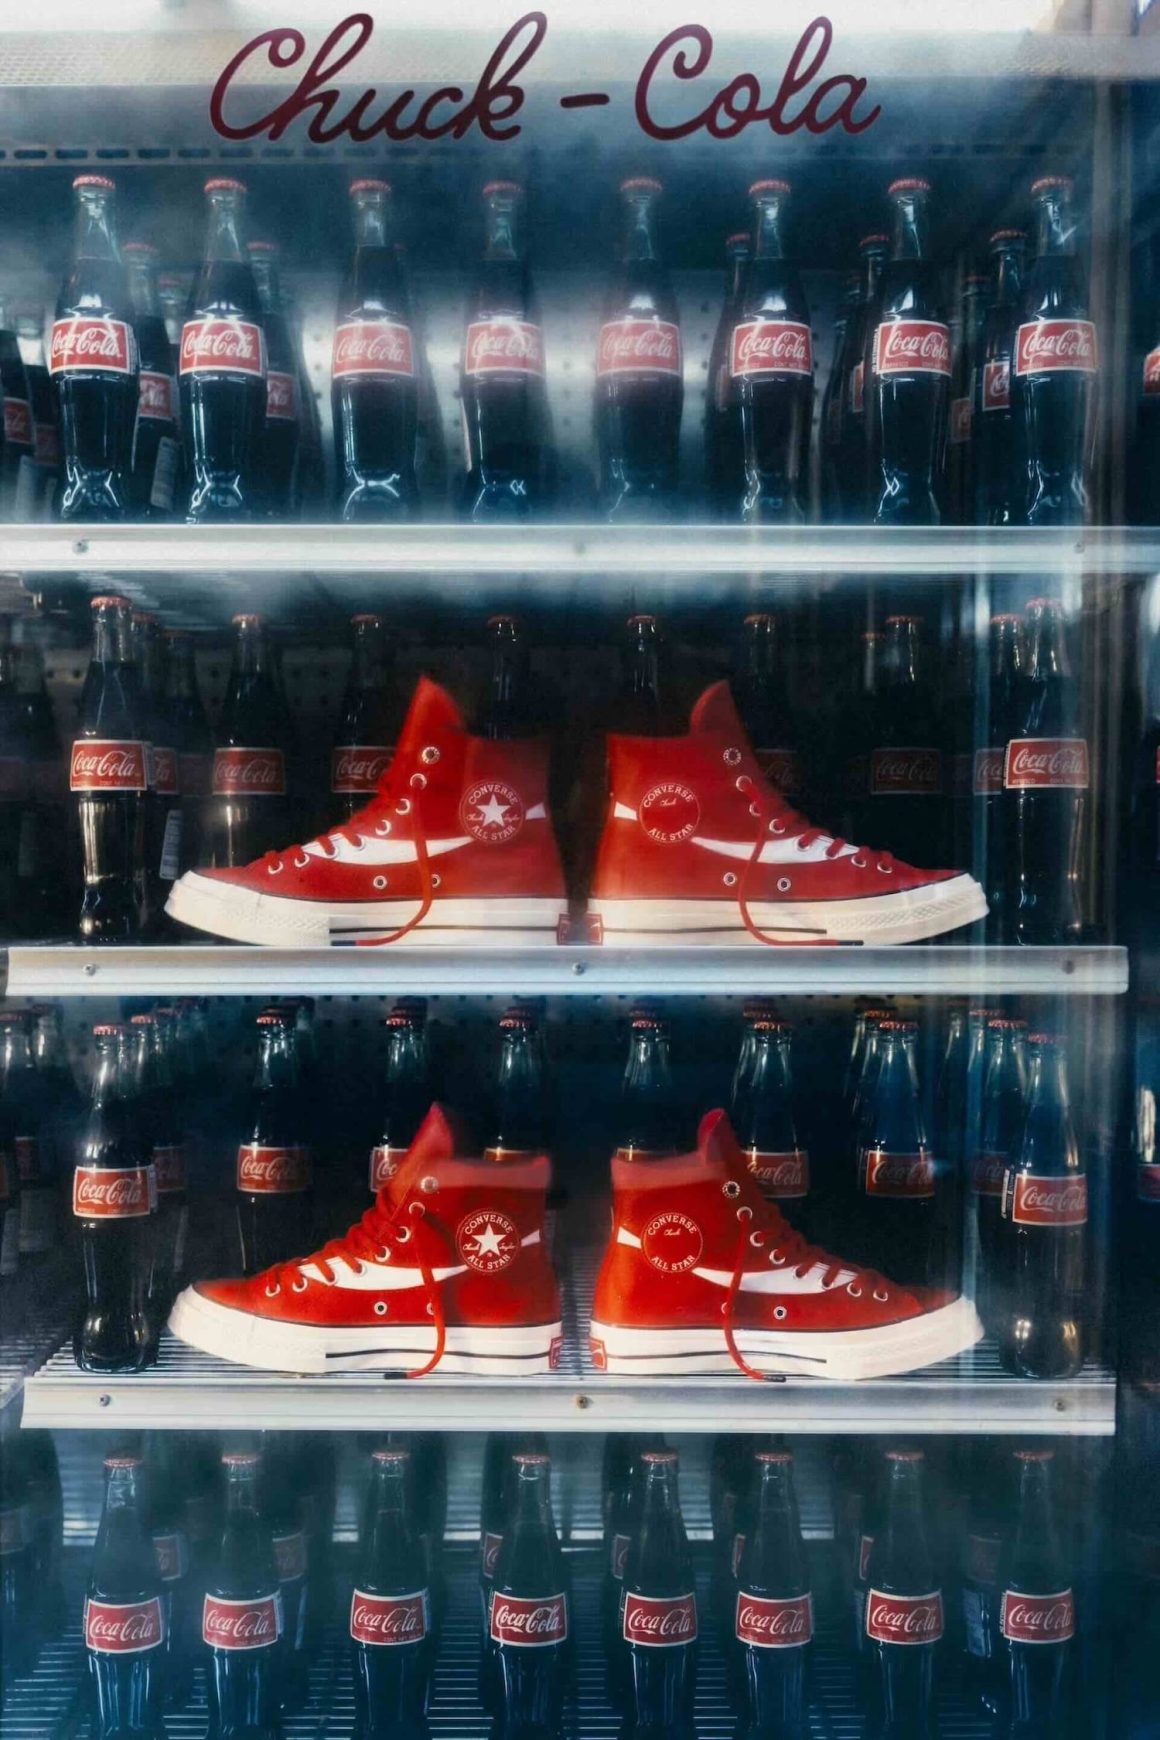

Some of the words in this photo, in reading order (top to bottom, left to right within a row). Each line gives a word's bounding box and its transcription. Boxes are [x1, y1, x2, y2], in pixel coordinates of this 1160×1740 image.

[209, 11, 547, 143] Chuck
[634, 16, 883, 141] Cola
[53, 325, 120, 357] Coca-Cola
[184, 329, 253, 358] Coca-Cola
[738, 331, 805, 360] Coca-Cola
[886, 330, 948, 359] Coca-Cola
[1022, 329, 1091, 360] Coca-Cola
[72, 751, 135, 777] Coca-Cola
[1013, 748, 1083, 776] Coca-Cola
[468, 785, 519, 805] CONVERSE
[643, 785, 694, 808] CONVERSE
[472, 825, 489, 840] ALL
[491, 825, 516, 841] STAR
[648, 827, 667, 841] ALL
[669, 823, 694, 841] STAR
[78, 1178, 143, 1205] Coca-Cola
[464, 1214, 514, 1235] CONVERSE
[647, 1214, 697, 1236] CONVERSE
[467, 1254, 484, 1269] ALL
[487, 1254, 511, 1270] STAR
[651, 1255, 668, 1270] ALL
[671, 1254, 695, 1270] STAR
[90, 1613, 153, 1641] Coca-Cola
[206, 1610, 269, 1637] Coca-Cola
[354, 1605, 416, 1633] Coca-Cola
[496, 1605, 559, 1633] Coca-Cola
[629, 1608, 690, 1635] Coca-Cola
[739, 1606, 804, 1634] Coca-Cola
[872, 1605, 936, 1632] Coca-Cola
[1008, 1602, 1072, 1630] Coca-Cola
